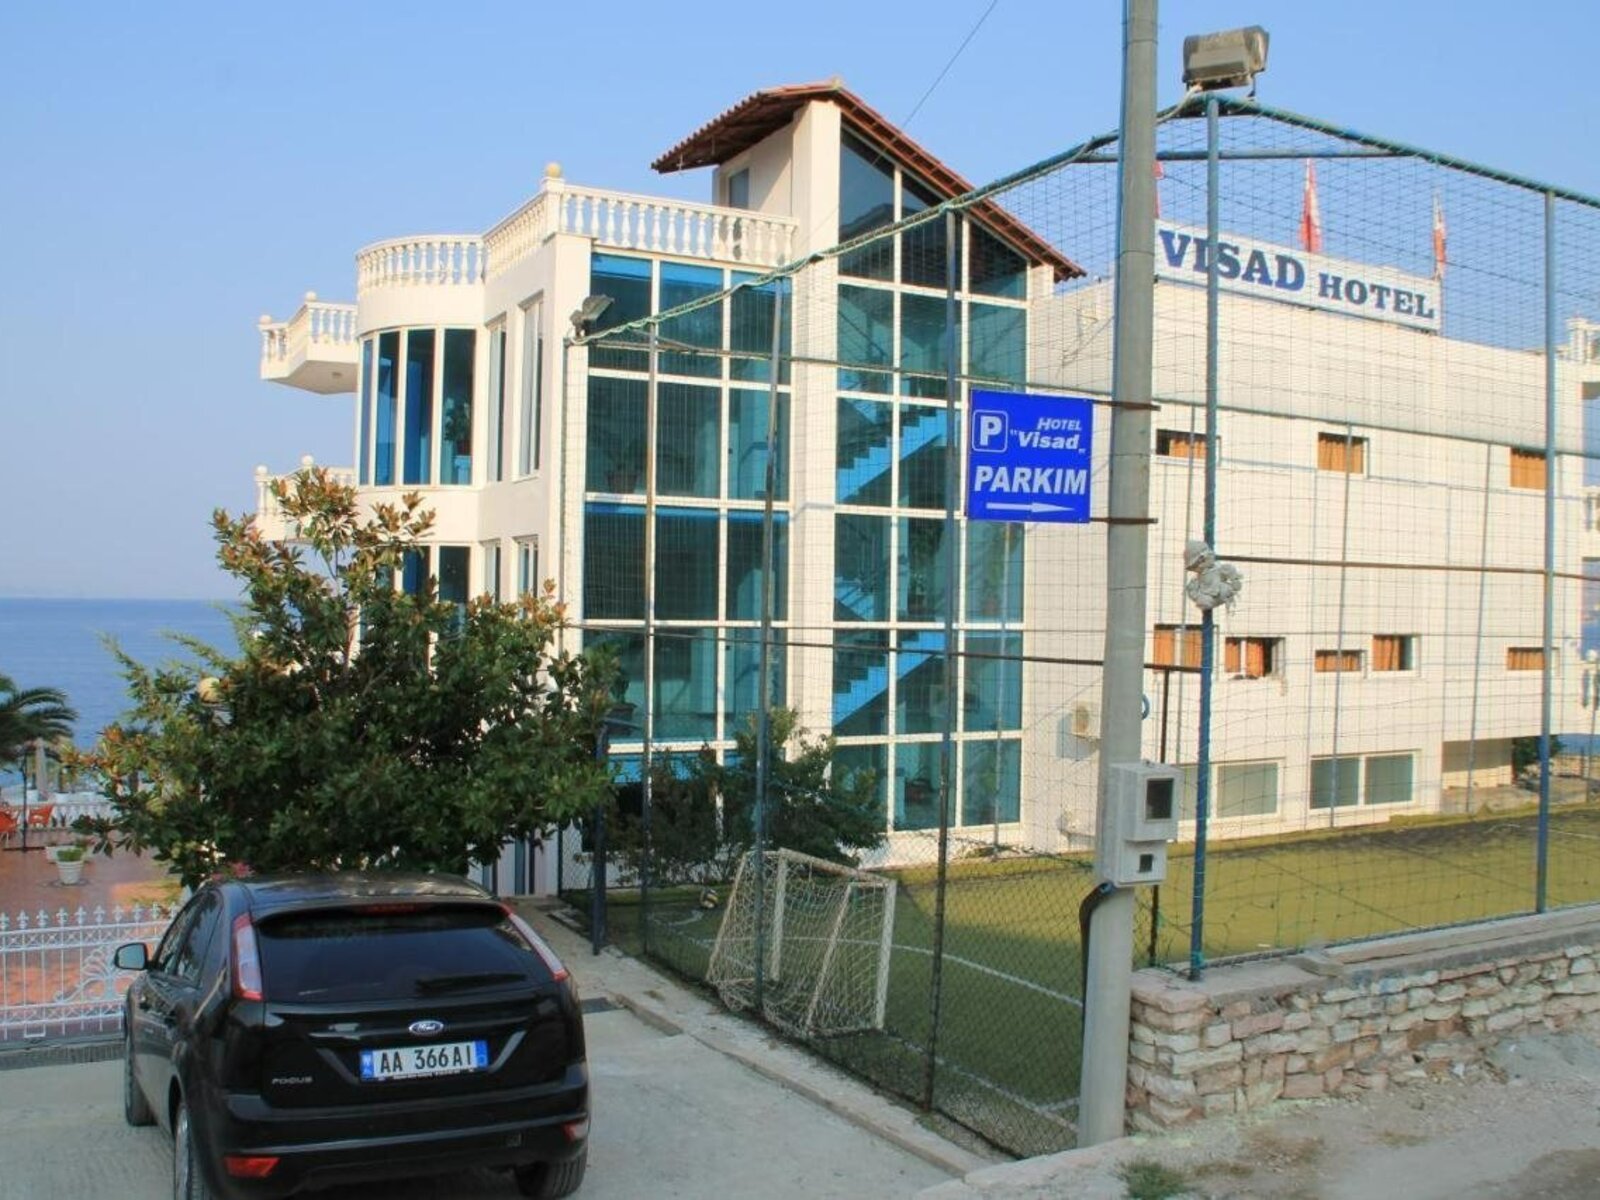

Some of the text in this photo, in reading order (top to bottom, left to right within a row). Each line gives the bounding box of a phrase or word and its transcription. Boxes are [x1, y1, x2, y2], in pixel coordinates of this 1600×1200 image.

[1158, 230, 1434, 319] VISAD HOTEL
[979, 415, 1002, 446] P
[1037, 417, 1082, 431] HOTEL
[974, 465, 1088, 495] PARKIM
[380, 1051, 403, 1073] AA
